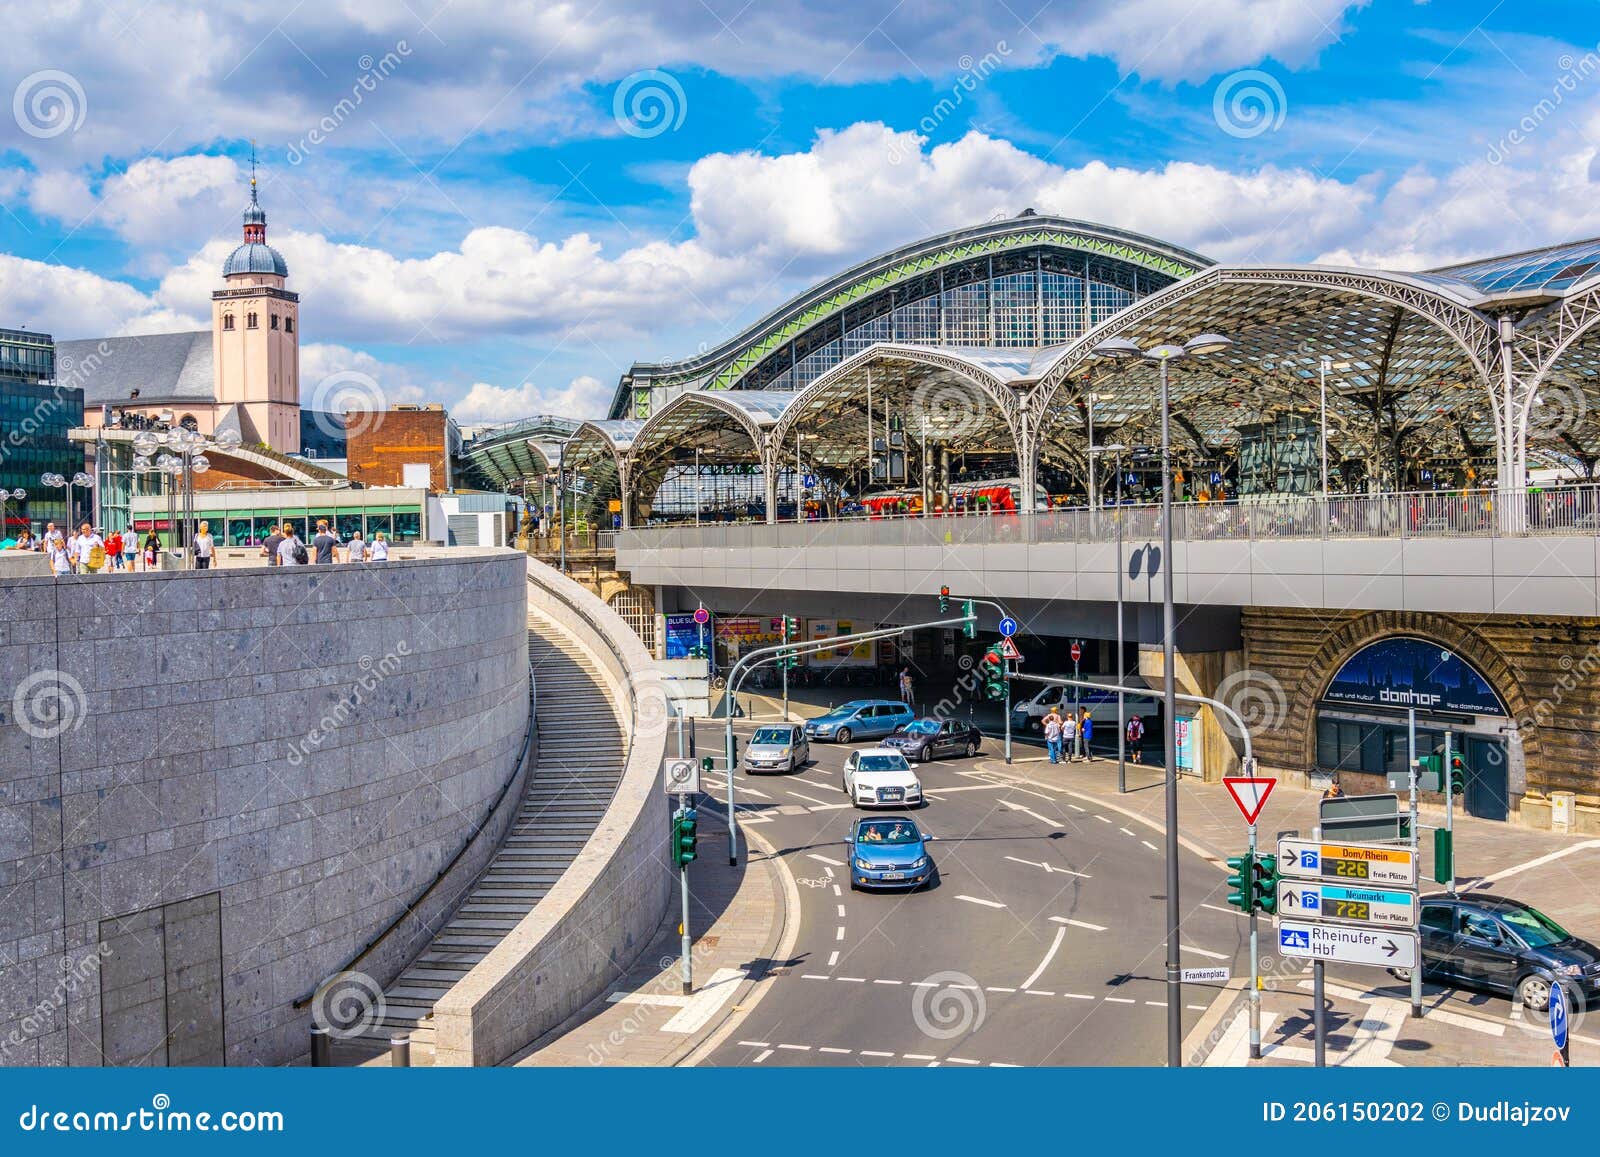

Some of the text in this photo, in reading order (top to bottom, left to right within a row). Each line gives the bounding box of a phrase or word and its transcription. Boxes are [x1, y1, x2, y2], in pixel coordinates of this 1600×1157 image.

[675, 767, 688, 778] 30
[1342, 848, 1389, 861] Dom/Rhein
[1336, 861, 1367, 878] 226
[1373, 871, 1387, 879] freie
[1345, 890, 1385, 902] Neumarkt
[1336, 901, 1369, 919] 722
[1373, 911, 1388, 920] freie
[1312, 928, 1378, 945] Rheinufer
[1312, 943, 1336, 956] Hbf
[1184, 970, 1226, 980] Frankenplatz
